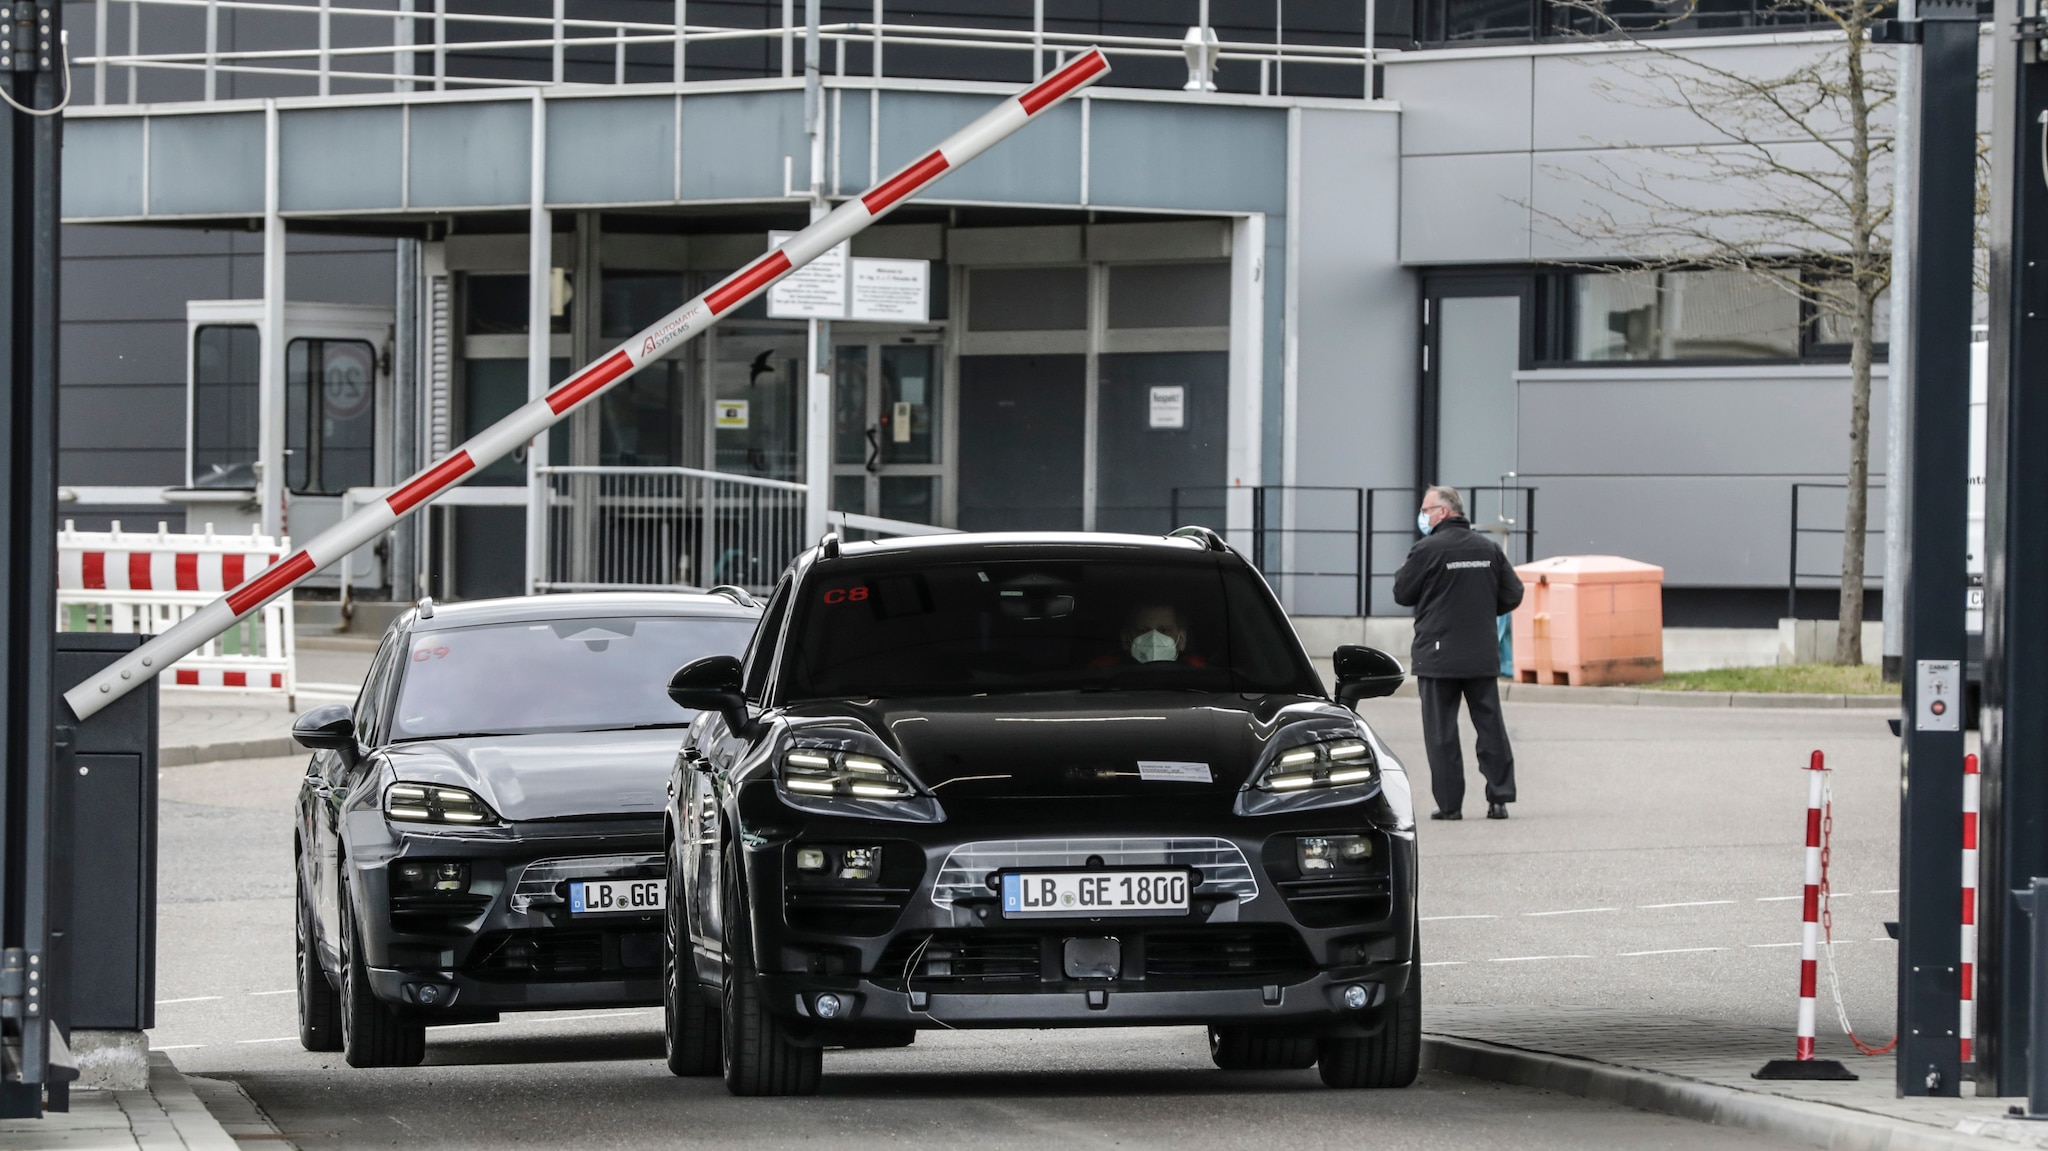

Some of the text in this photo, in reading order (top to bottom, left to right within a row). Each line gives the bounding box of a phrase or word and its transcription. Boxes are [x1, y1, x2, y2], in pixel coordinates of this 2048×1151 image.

[654, 306, 700, 340] AUTOMATIC
[656, 322, 690, 348] SYSTEMS
[823, 586, 869, 604] C8
[413, 645, 449, 662] C9
[585, 883, 659, 909] LB GG
[1023, 876, 1185, 907] LB GE 1800
